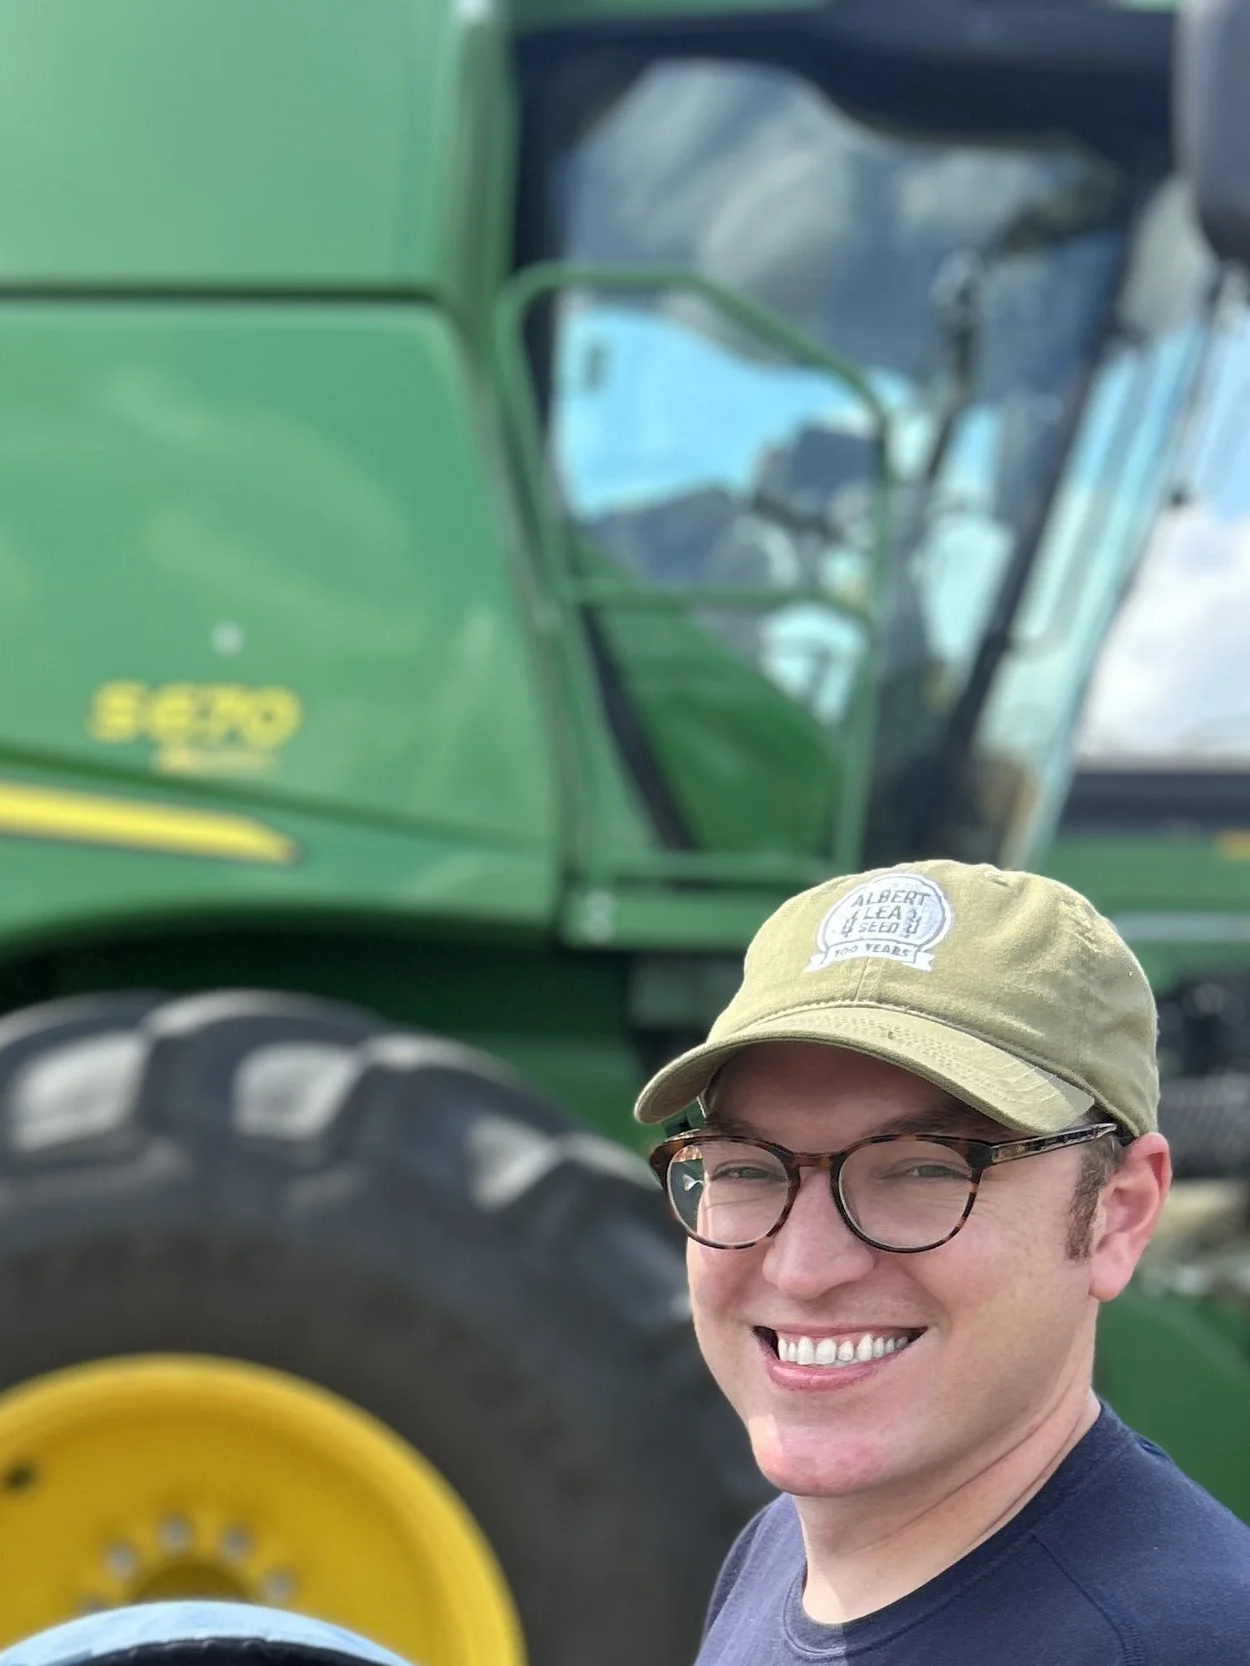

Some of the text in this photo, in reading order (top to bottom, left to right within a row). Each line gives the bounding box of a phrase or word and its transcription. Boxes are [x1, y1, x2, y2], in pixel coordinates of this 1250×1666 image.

[851, 889, 931, 907] ALBERT
[862, 905, 901, 920] LEA
[858, 921, 900, 933] SEED
[865, 943, 910, 957] YEARS
